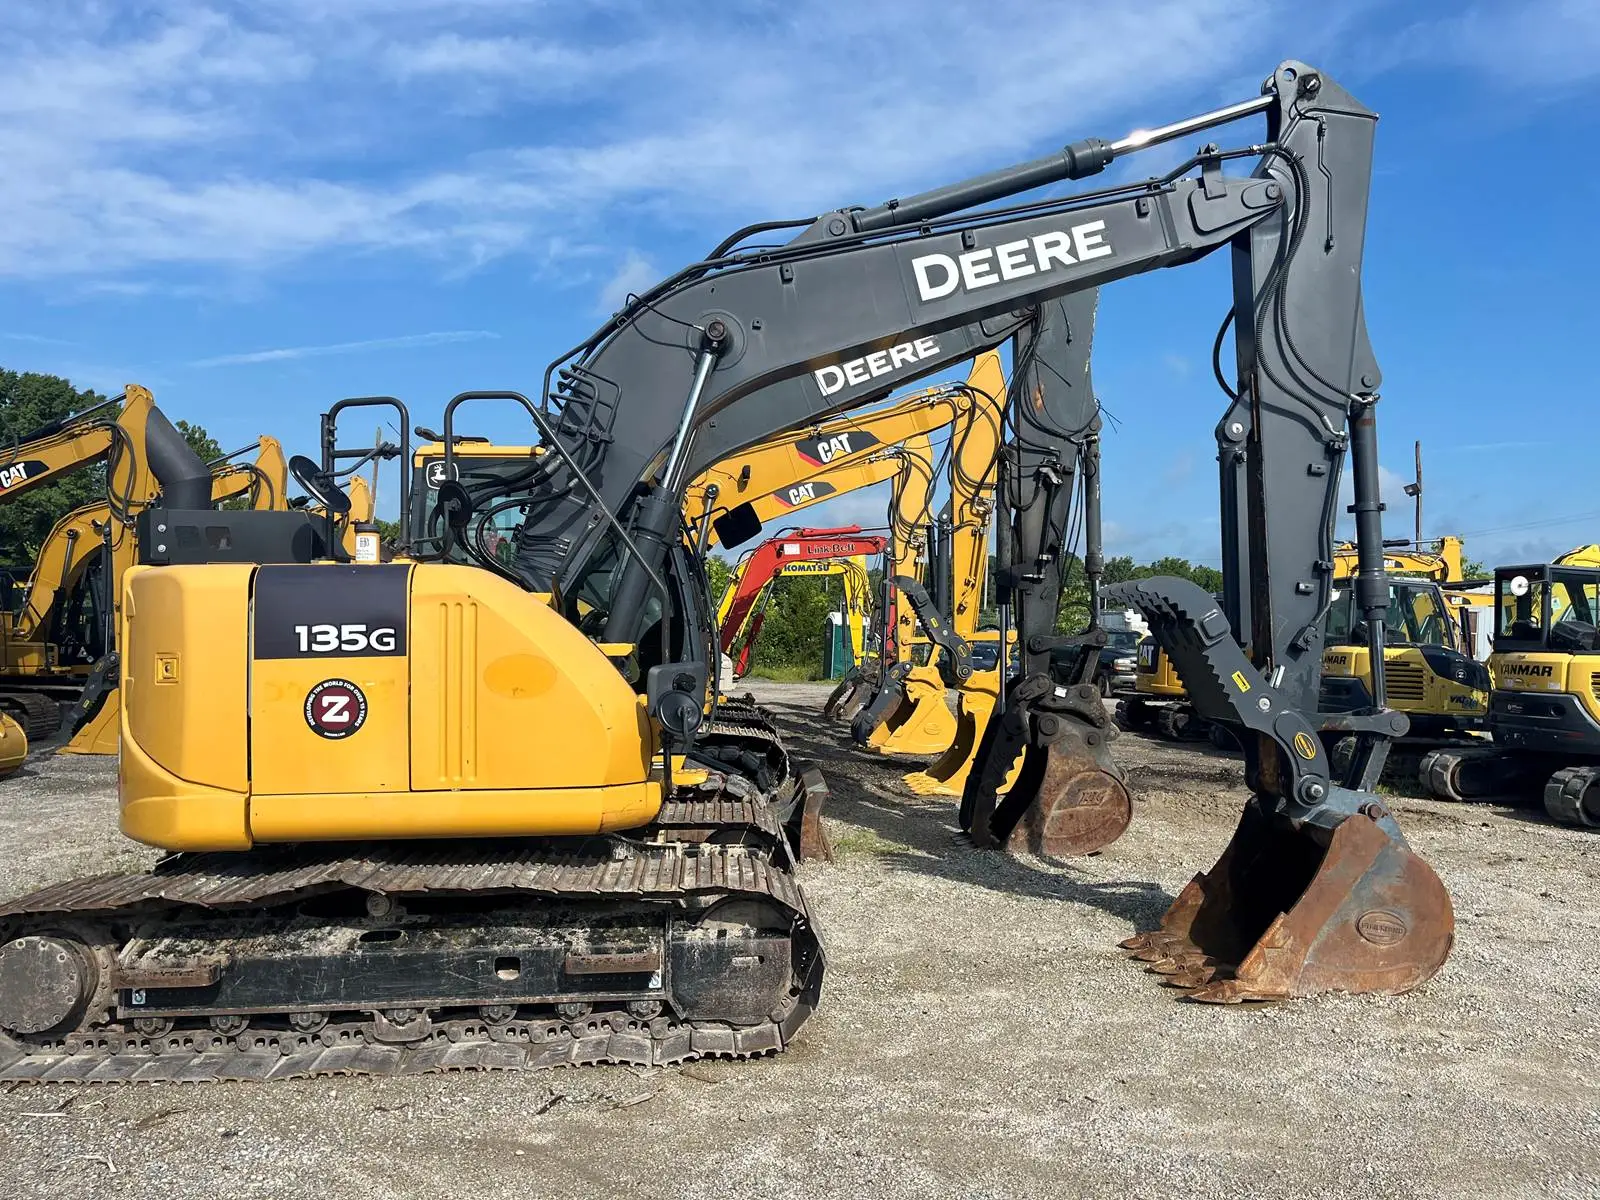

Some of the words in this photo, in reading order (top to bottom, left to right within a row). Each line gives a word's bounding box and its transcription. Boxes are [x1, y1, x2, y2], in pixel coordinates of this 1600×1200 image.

[911, 219, 1112, 302] DEERE
[814, 335, 940, 396] DEERE
[816, 432, 852, 463] CAT
[0, 462, 28, 488] CAT
[788, 482, 816, 505] CAT
[784, 564, 830, 572] KOMATSU
[1384, 559, 1396, 568] CAT
[1451, 596, 1463, 605] CAT
[295, 624, 395, 652] 135G
[1324, 655, 1347, 665] MAR
[1500, 664, 1553, 677] YANMAR
[313, 685, 324, 694] THE
[344, 682, 355, 691] FOR
[353, 689, 364, 702] OVER
[321, 695, 350, 723] Z
[354, 710, 365, 727] YEARS
